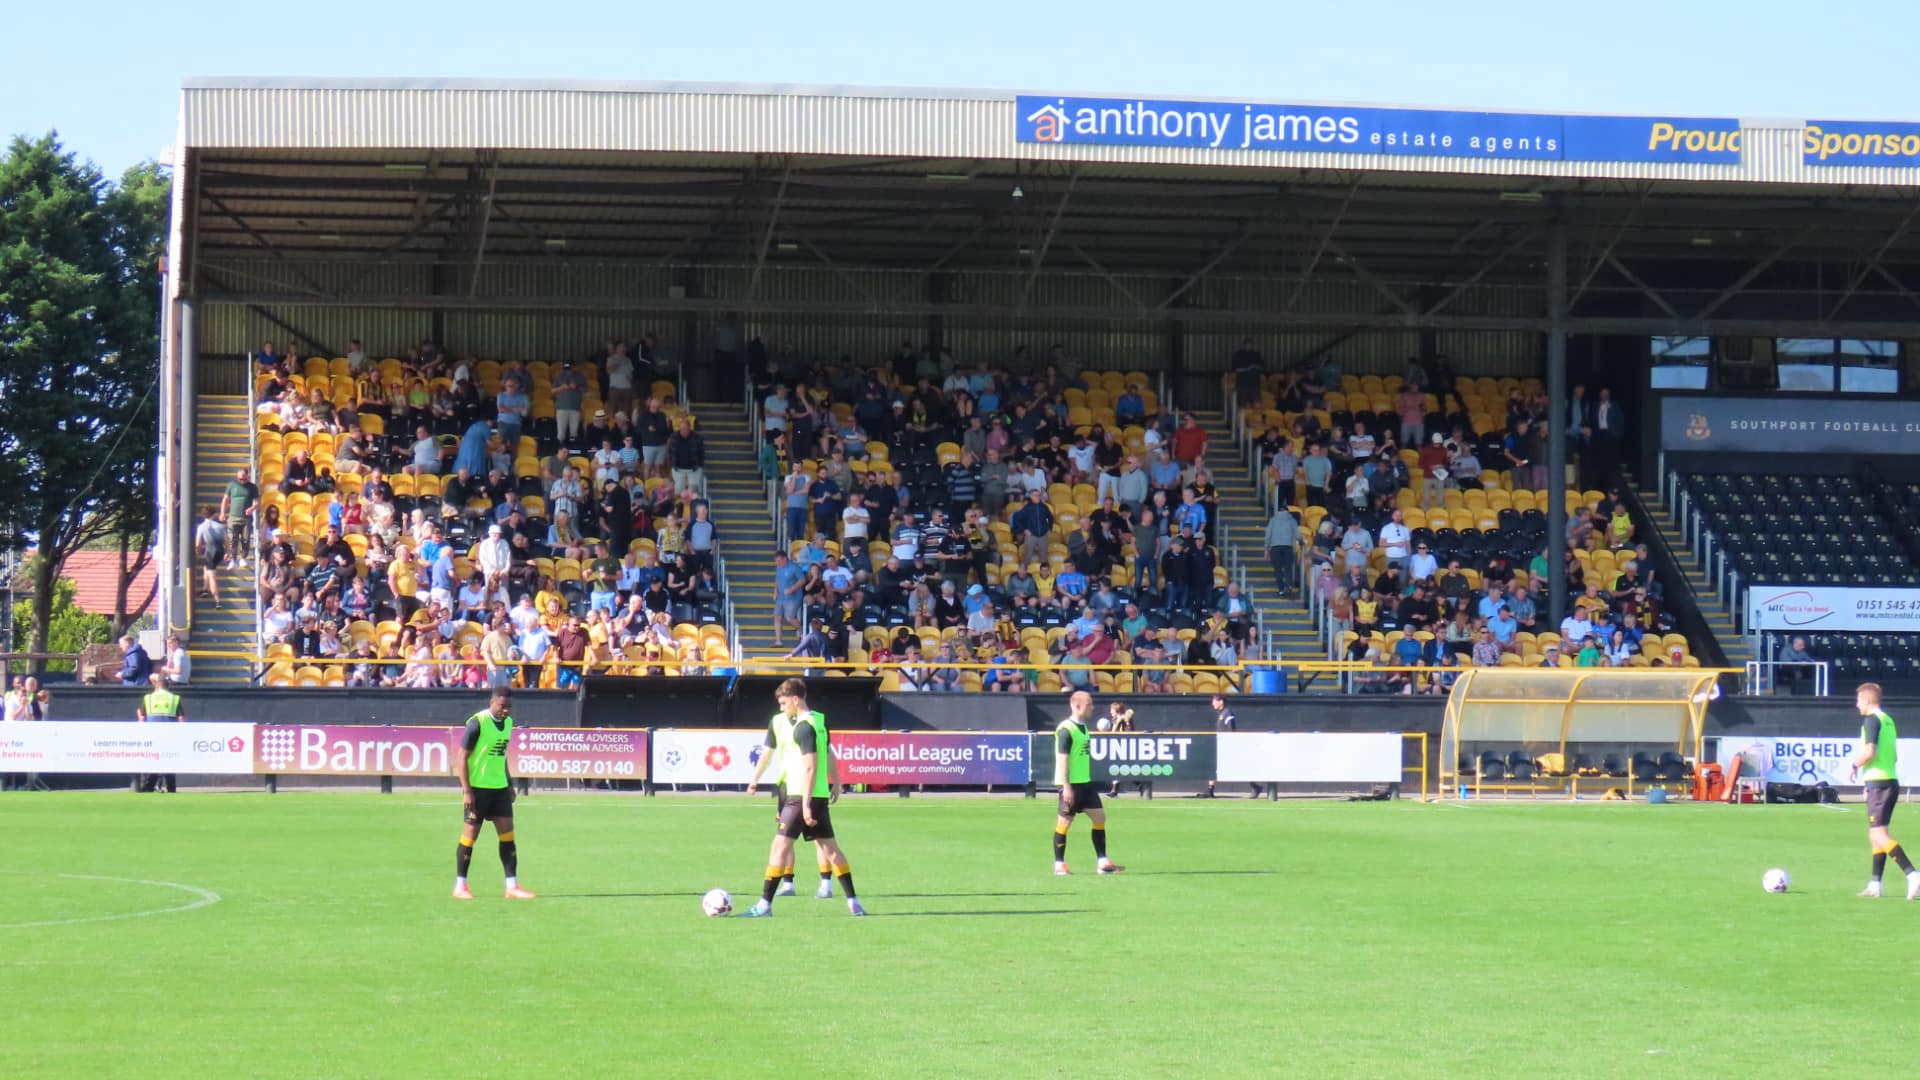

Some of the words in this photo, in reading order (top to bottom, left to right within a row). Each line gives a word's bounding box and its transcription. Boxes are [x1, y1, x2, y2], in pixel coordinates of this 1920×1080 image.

[1074, 101, 1232, 147] anthony
[1240, 105, 1360, 148] james
[1369, 131, 1452, 148] estate
[1469, 135, 1558, 152] agents
[1730, 420, 1816, 431] SOUTHPORT
[1824, 421, 1898, 433] FOOTBALL
[1856, 599, 1882, 610] 0151
[1885, 600, 1906, 610] 545
[193, 736, 225, 752] real
[529, 732, 584, 742] MORTGAGE
[586, 733, 629, 743] ADVISERS
[300, 728, 448, 773] Barron
[529, 742, 590, 752] PROTECTION
[592, 743, 634, 753] ADVISERS
[830, 743, 905, 761] National
[909, 744, 974, 766] League
[977, 744, 1024, 762] Trust
[1089, 738, 1192, 761] UNIBET
[1775, 742, 1806, 757] BIG
[1811, 743, 1852, 757] HELP
[518, 759, 558, 774] 0800
[561, 760, 592, 774] 587
[594, 760, 634, 775] 0140
[848, 764, 895, 775] Supporting
[896, 765, 917, 775] your
[918, 765, 966, 775] community
